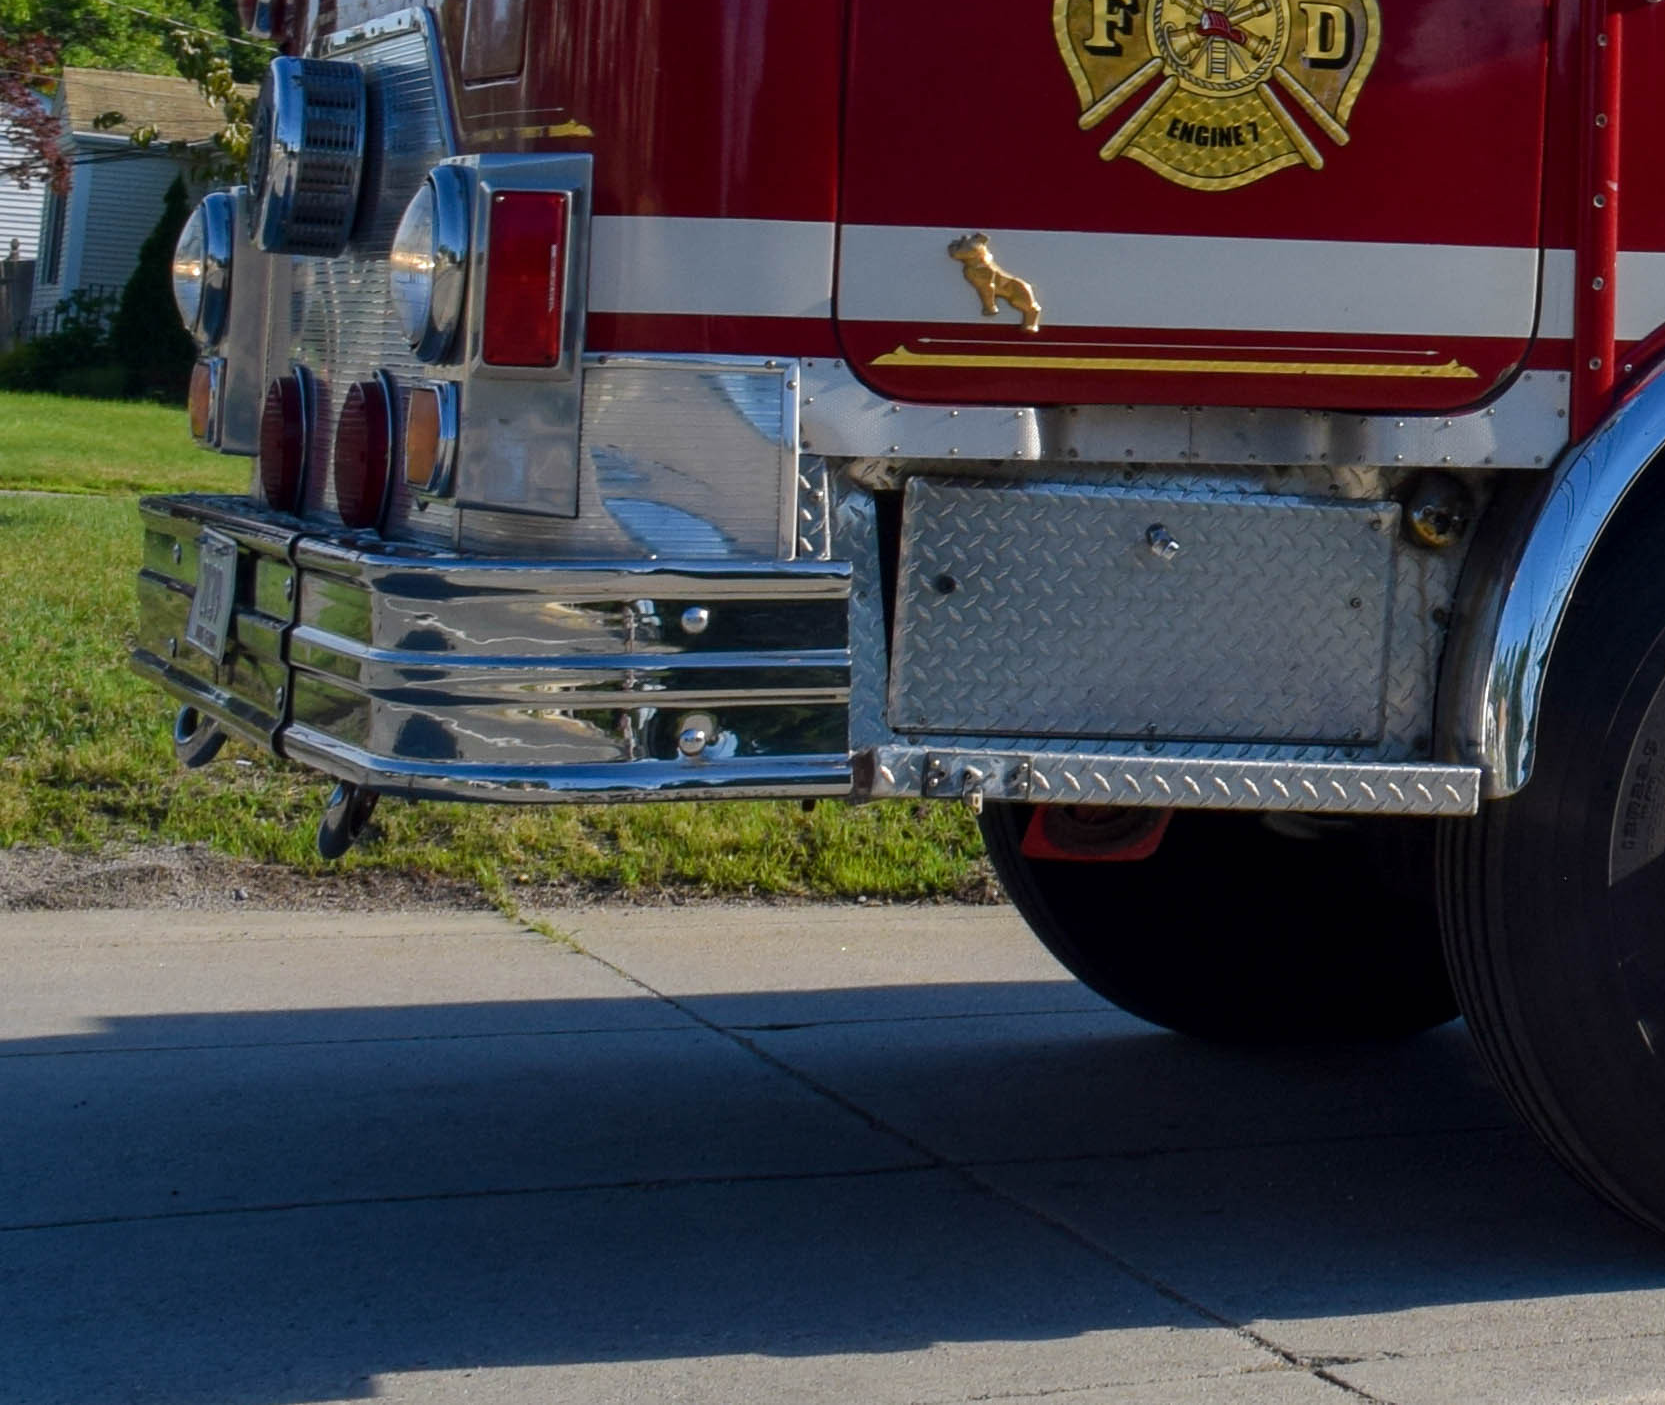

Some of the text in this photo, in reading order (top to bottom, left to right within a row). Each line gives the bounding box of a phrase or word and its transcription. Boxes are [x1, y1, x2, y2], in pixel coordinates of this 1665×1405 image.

[1298, 1, 1354, 69] D
[1166, 117, 1261, 148] ENGINE 7
